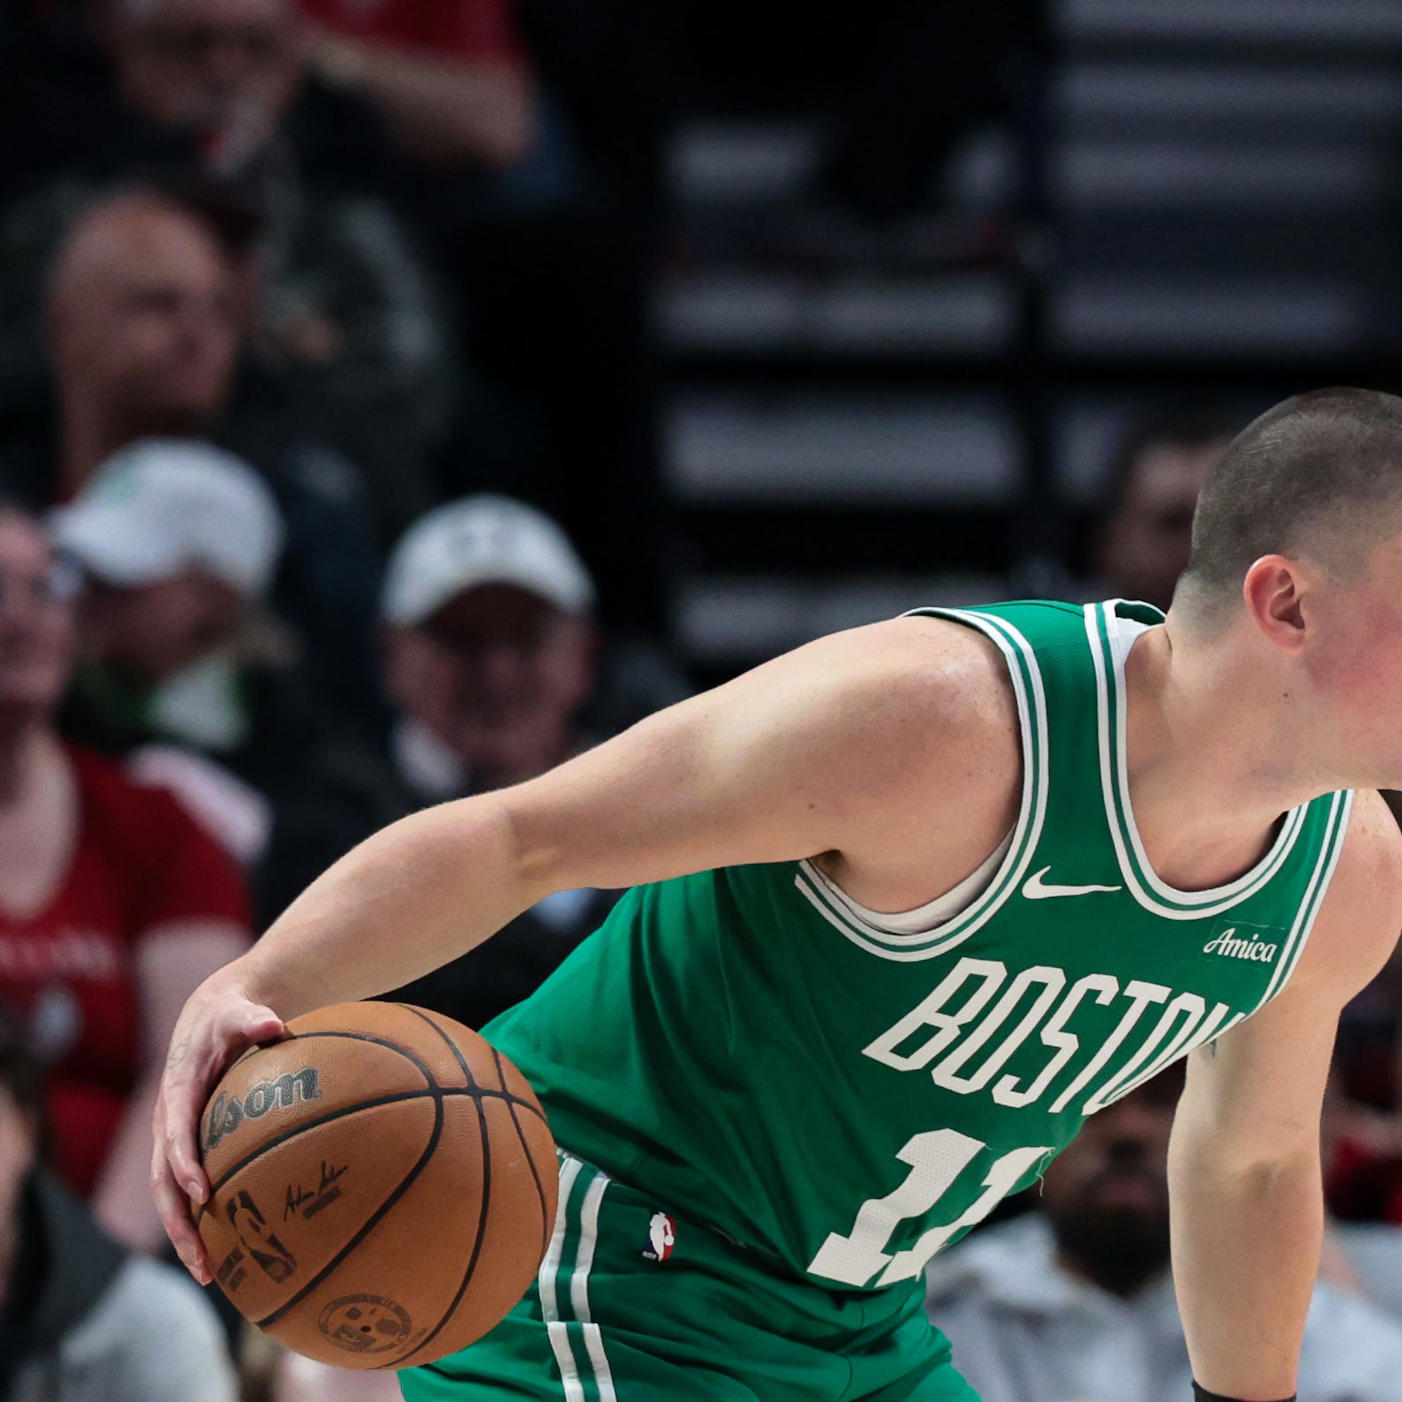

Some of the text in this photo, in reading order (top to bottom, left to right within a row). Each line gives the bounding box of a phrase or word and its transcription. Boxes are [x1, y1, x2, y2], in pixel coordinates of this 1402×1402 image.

[1203, 927, 1278, 963] Amica
[862, 956, 1247, 1116] BOSTON
[806, 1127, 1057, 1288] 11
